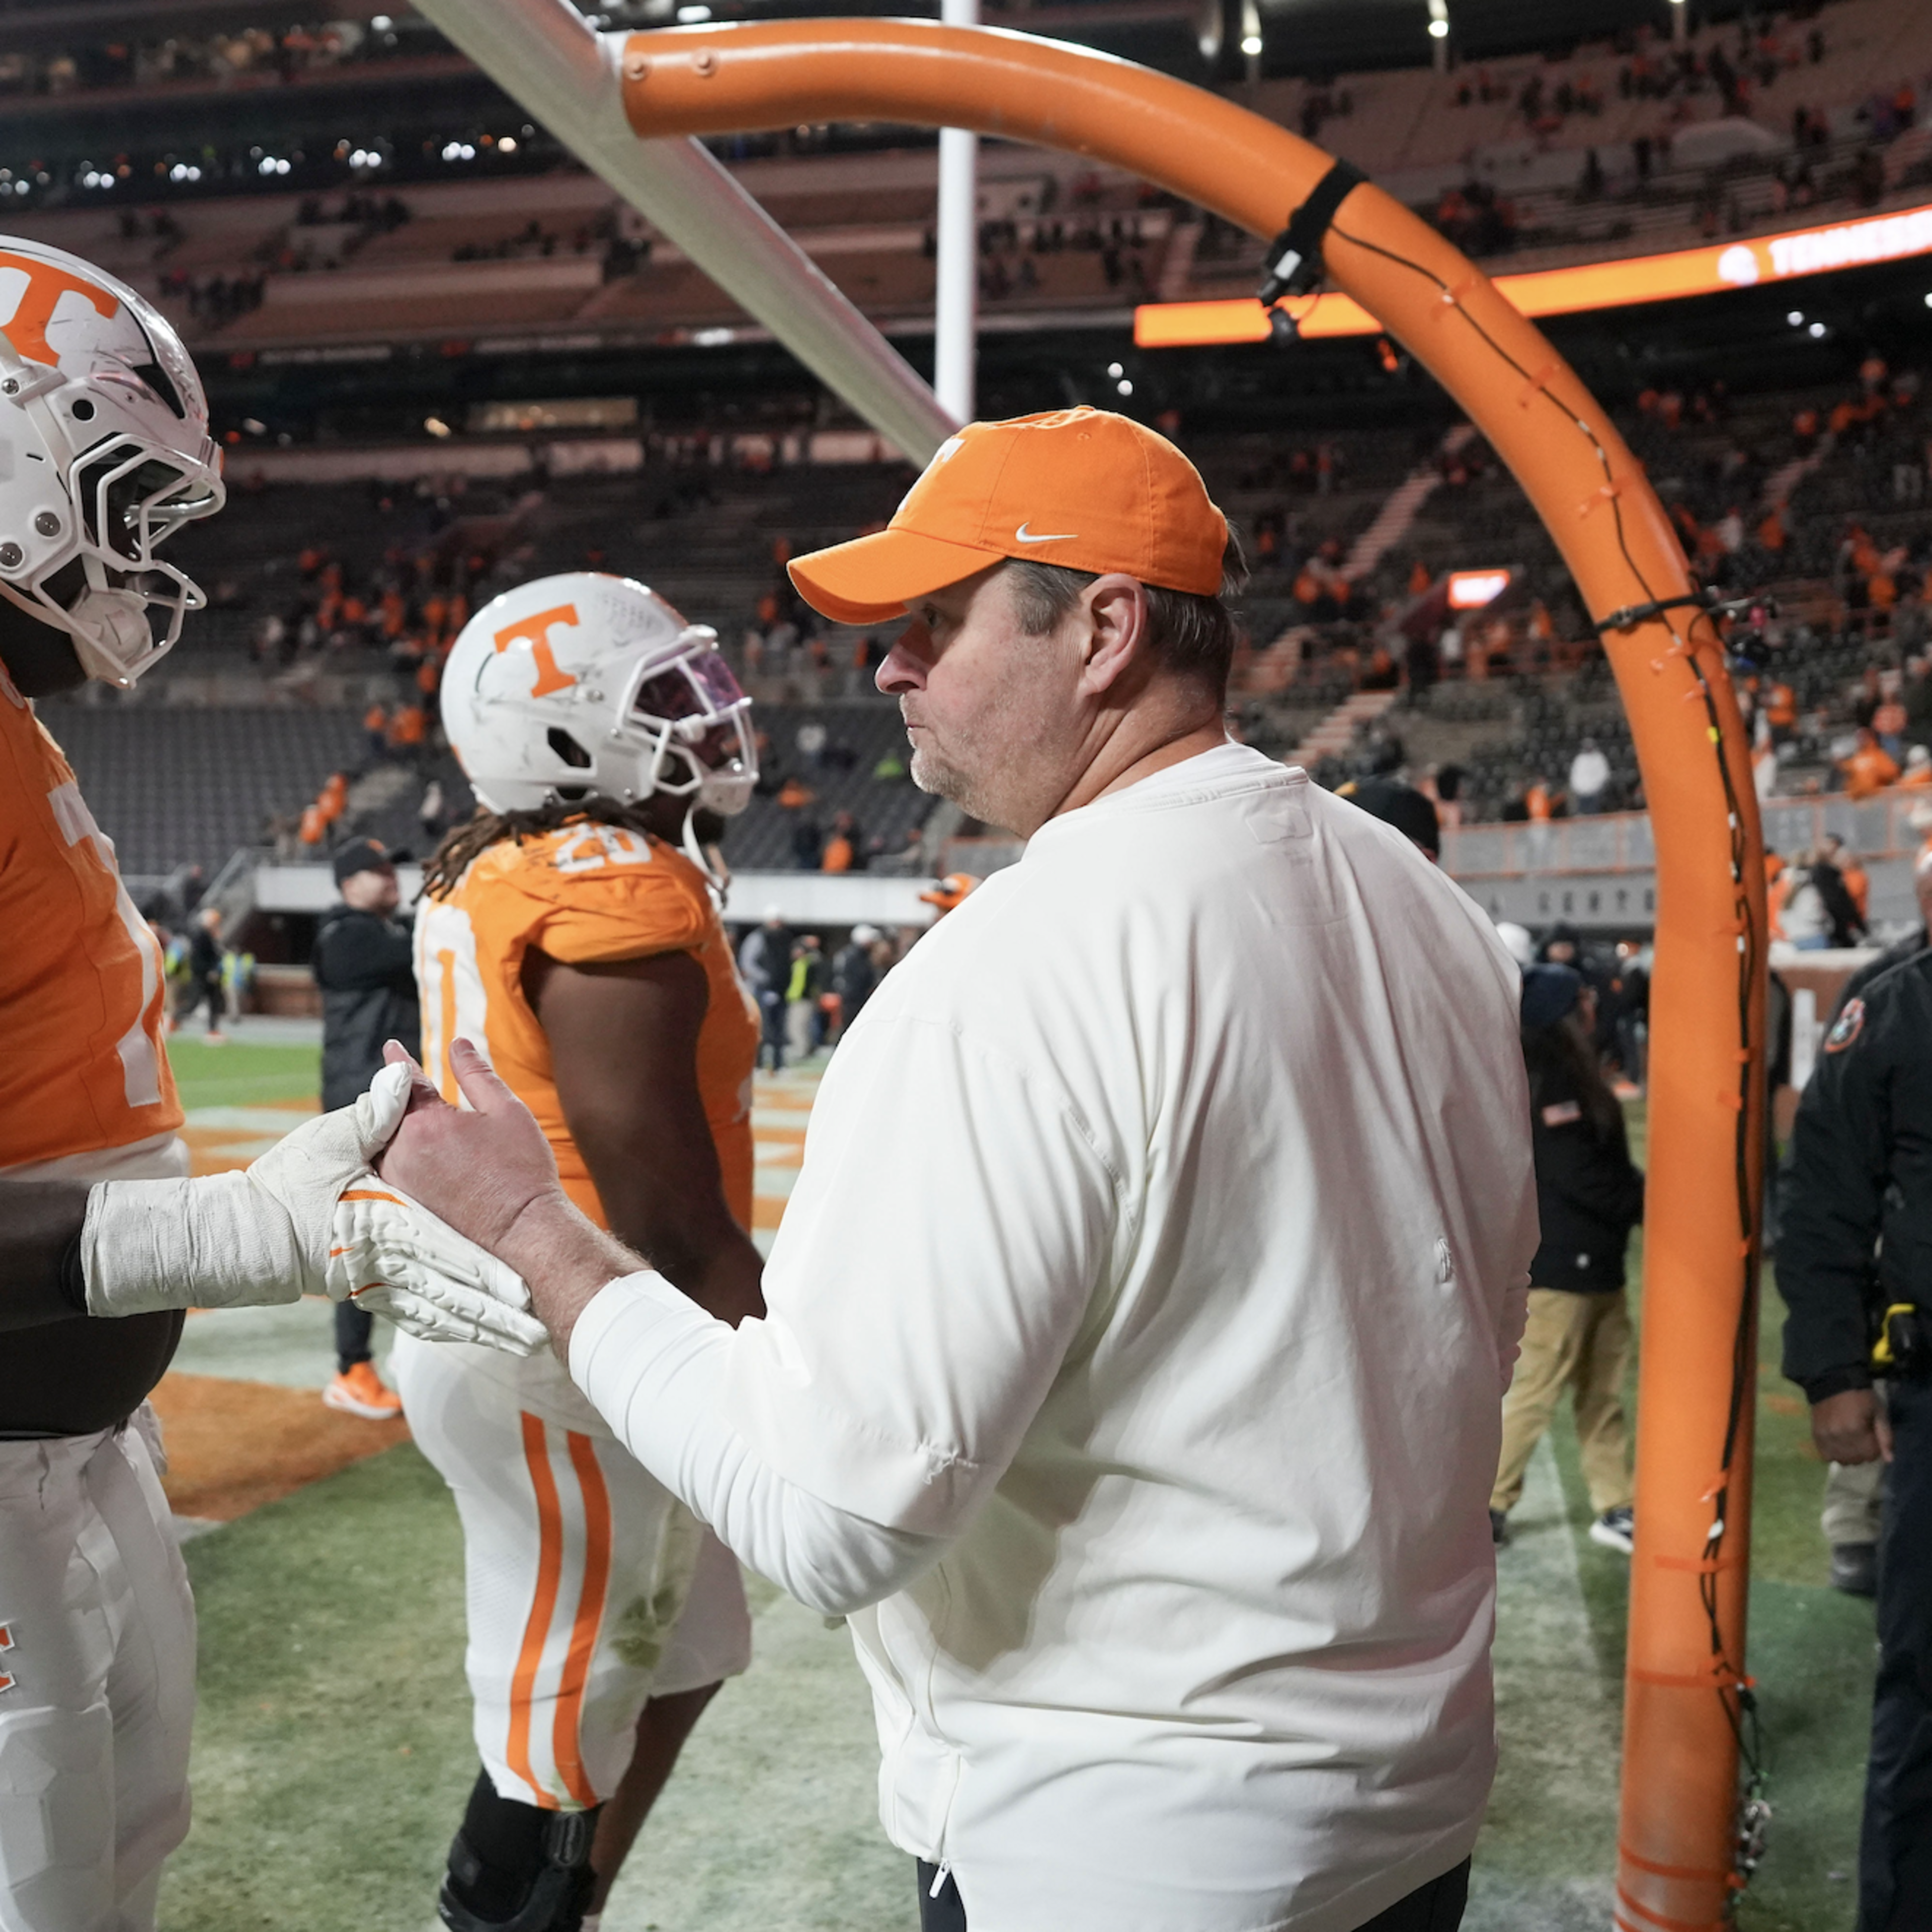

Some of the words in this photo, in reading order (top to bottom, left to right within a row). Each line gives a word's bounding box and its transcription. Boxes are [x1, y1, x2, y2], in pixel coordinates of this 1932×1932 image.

[0, 251, 120, 367] T
[494, 602, 580, 699] T
[550, 822, 653, 873] 20
